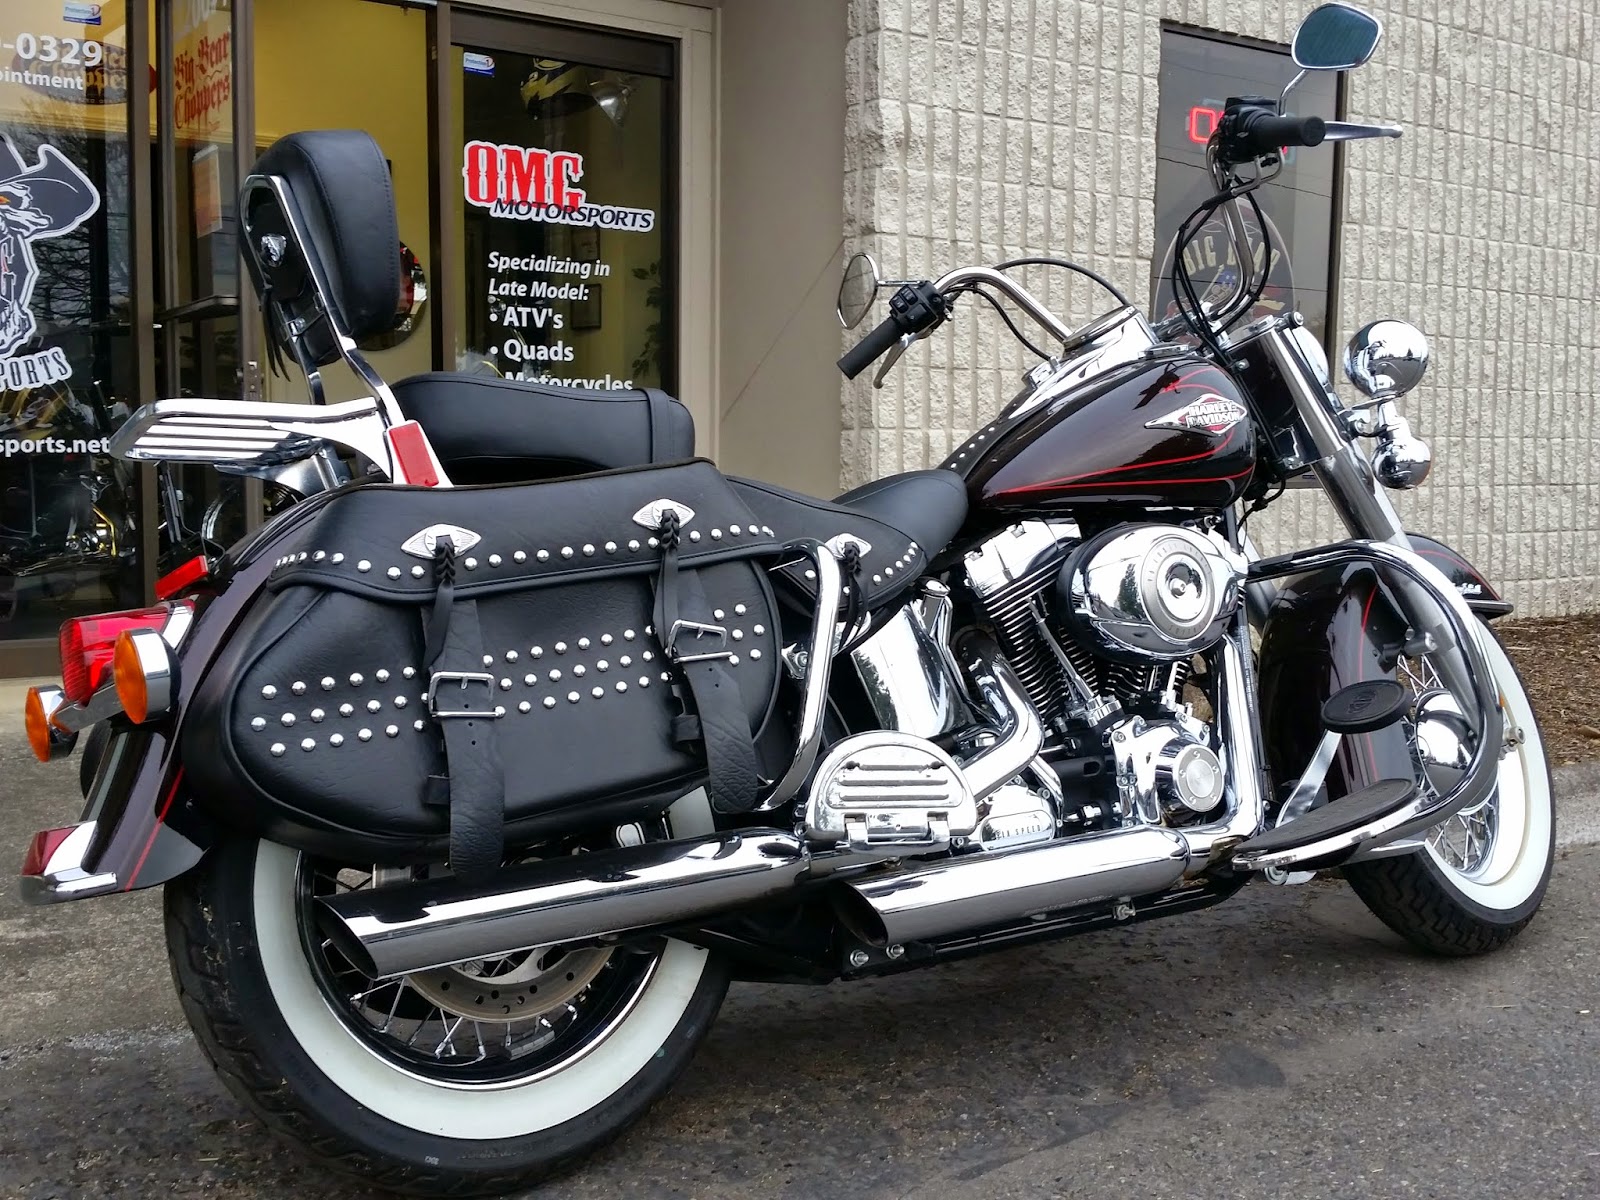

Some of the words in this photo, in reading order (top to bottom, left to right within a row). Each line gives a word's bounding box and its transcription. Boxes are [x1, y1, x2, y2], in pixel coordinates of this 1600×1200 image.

[464, 142, 584, 212] OMG
[493, 197, 653, 229] MOTORSPORTS
[487, 251, 591, 280] Specializing
[593, 259, 612, 277] in
[488, 278, 528, 297] Late
[530, 281, 590, 301] Model:
[502, 306, 564, 330] ATV's
[503, 338, 575, 363] Quads
